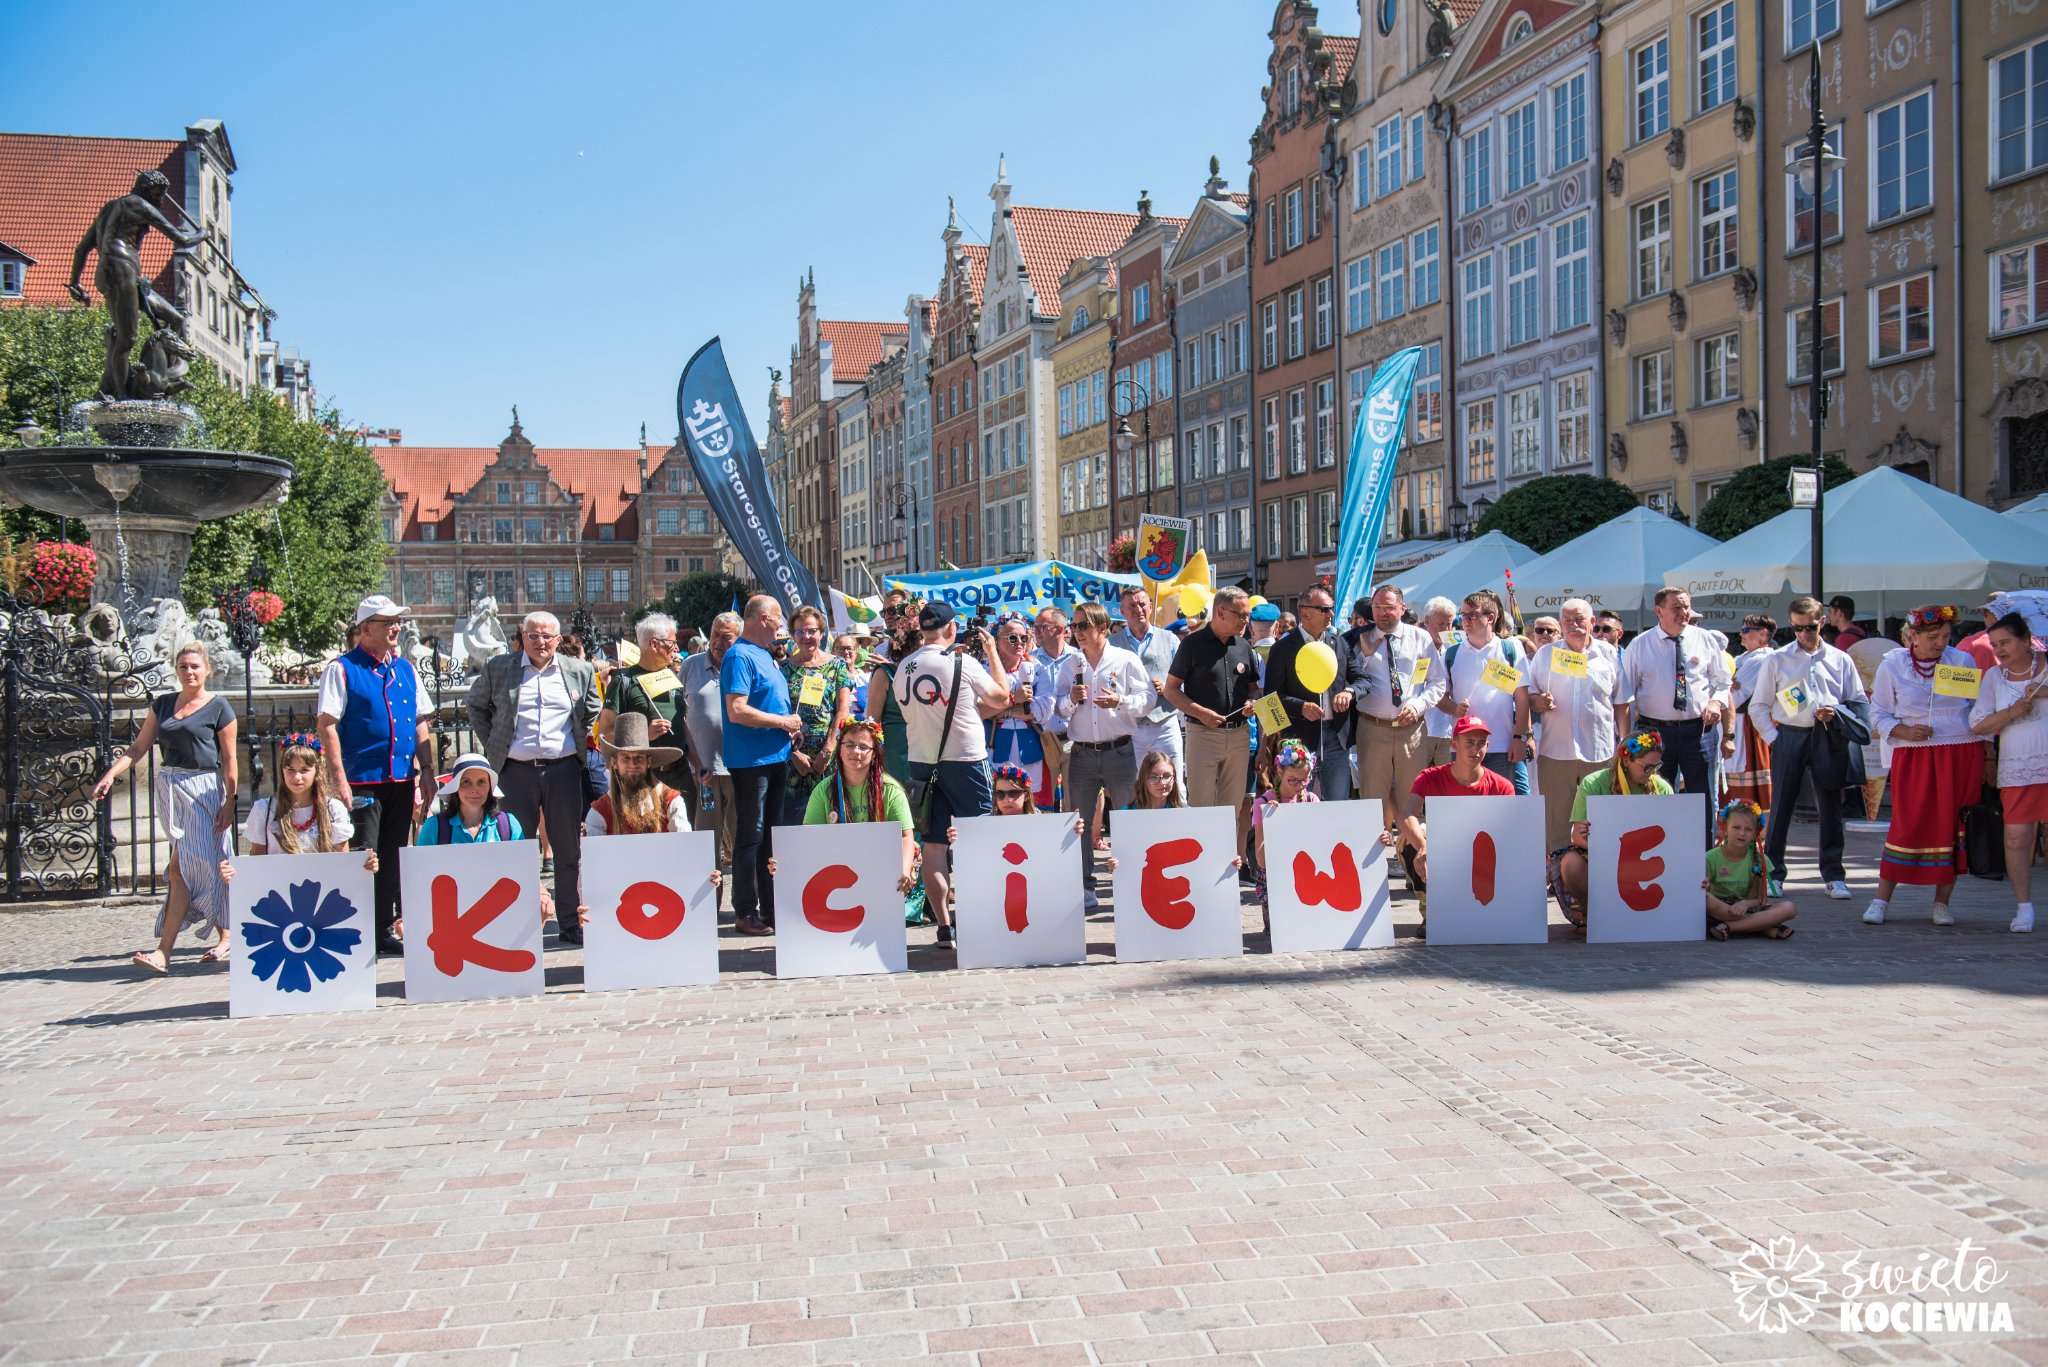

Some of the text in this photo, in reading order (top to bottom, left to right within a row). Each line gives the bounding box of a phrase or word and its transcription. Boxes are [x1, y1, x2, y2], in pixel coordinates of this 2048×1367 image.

[721, 456, 803, 608] Starogard Gda
[1142, 515, 1188, 530] KOCIEWIE
[942, 577, 1130, 608] RODZĄ SIĘ GW
